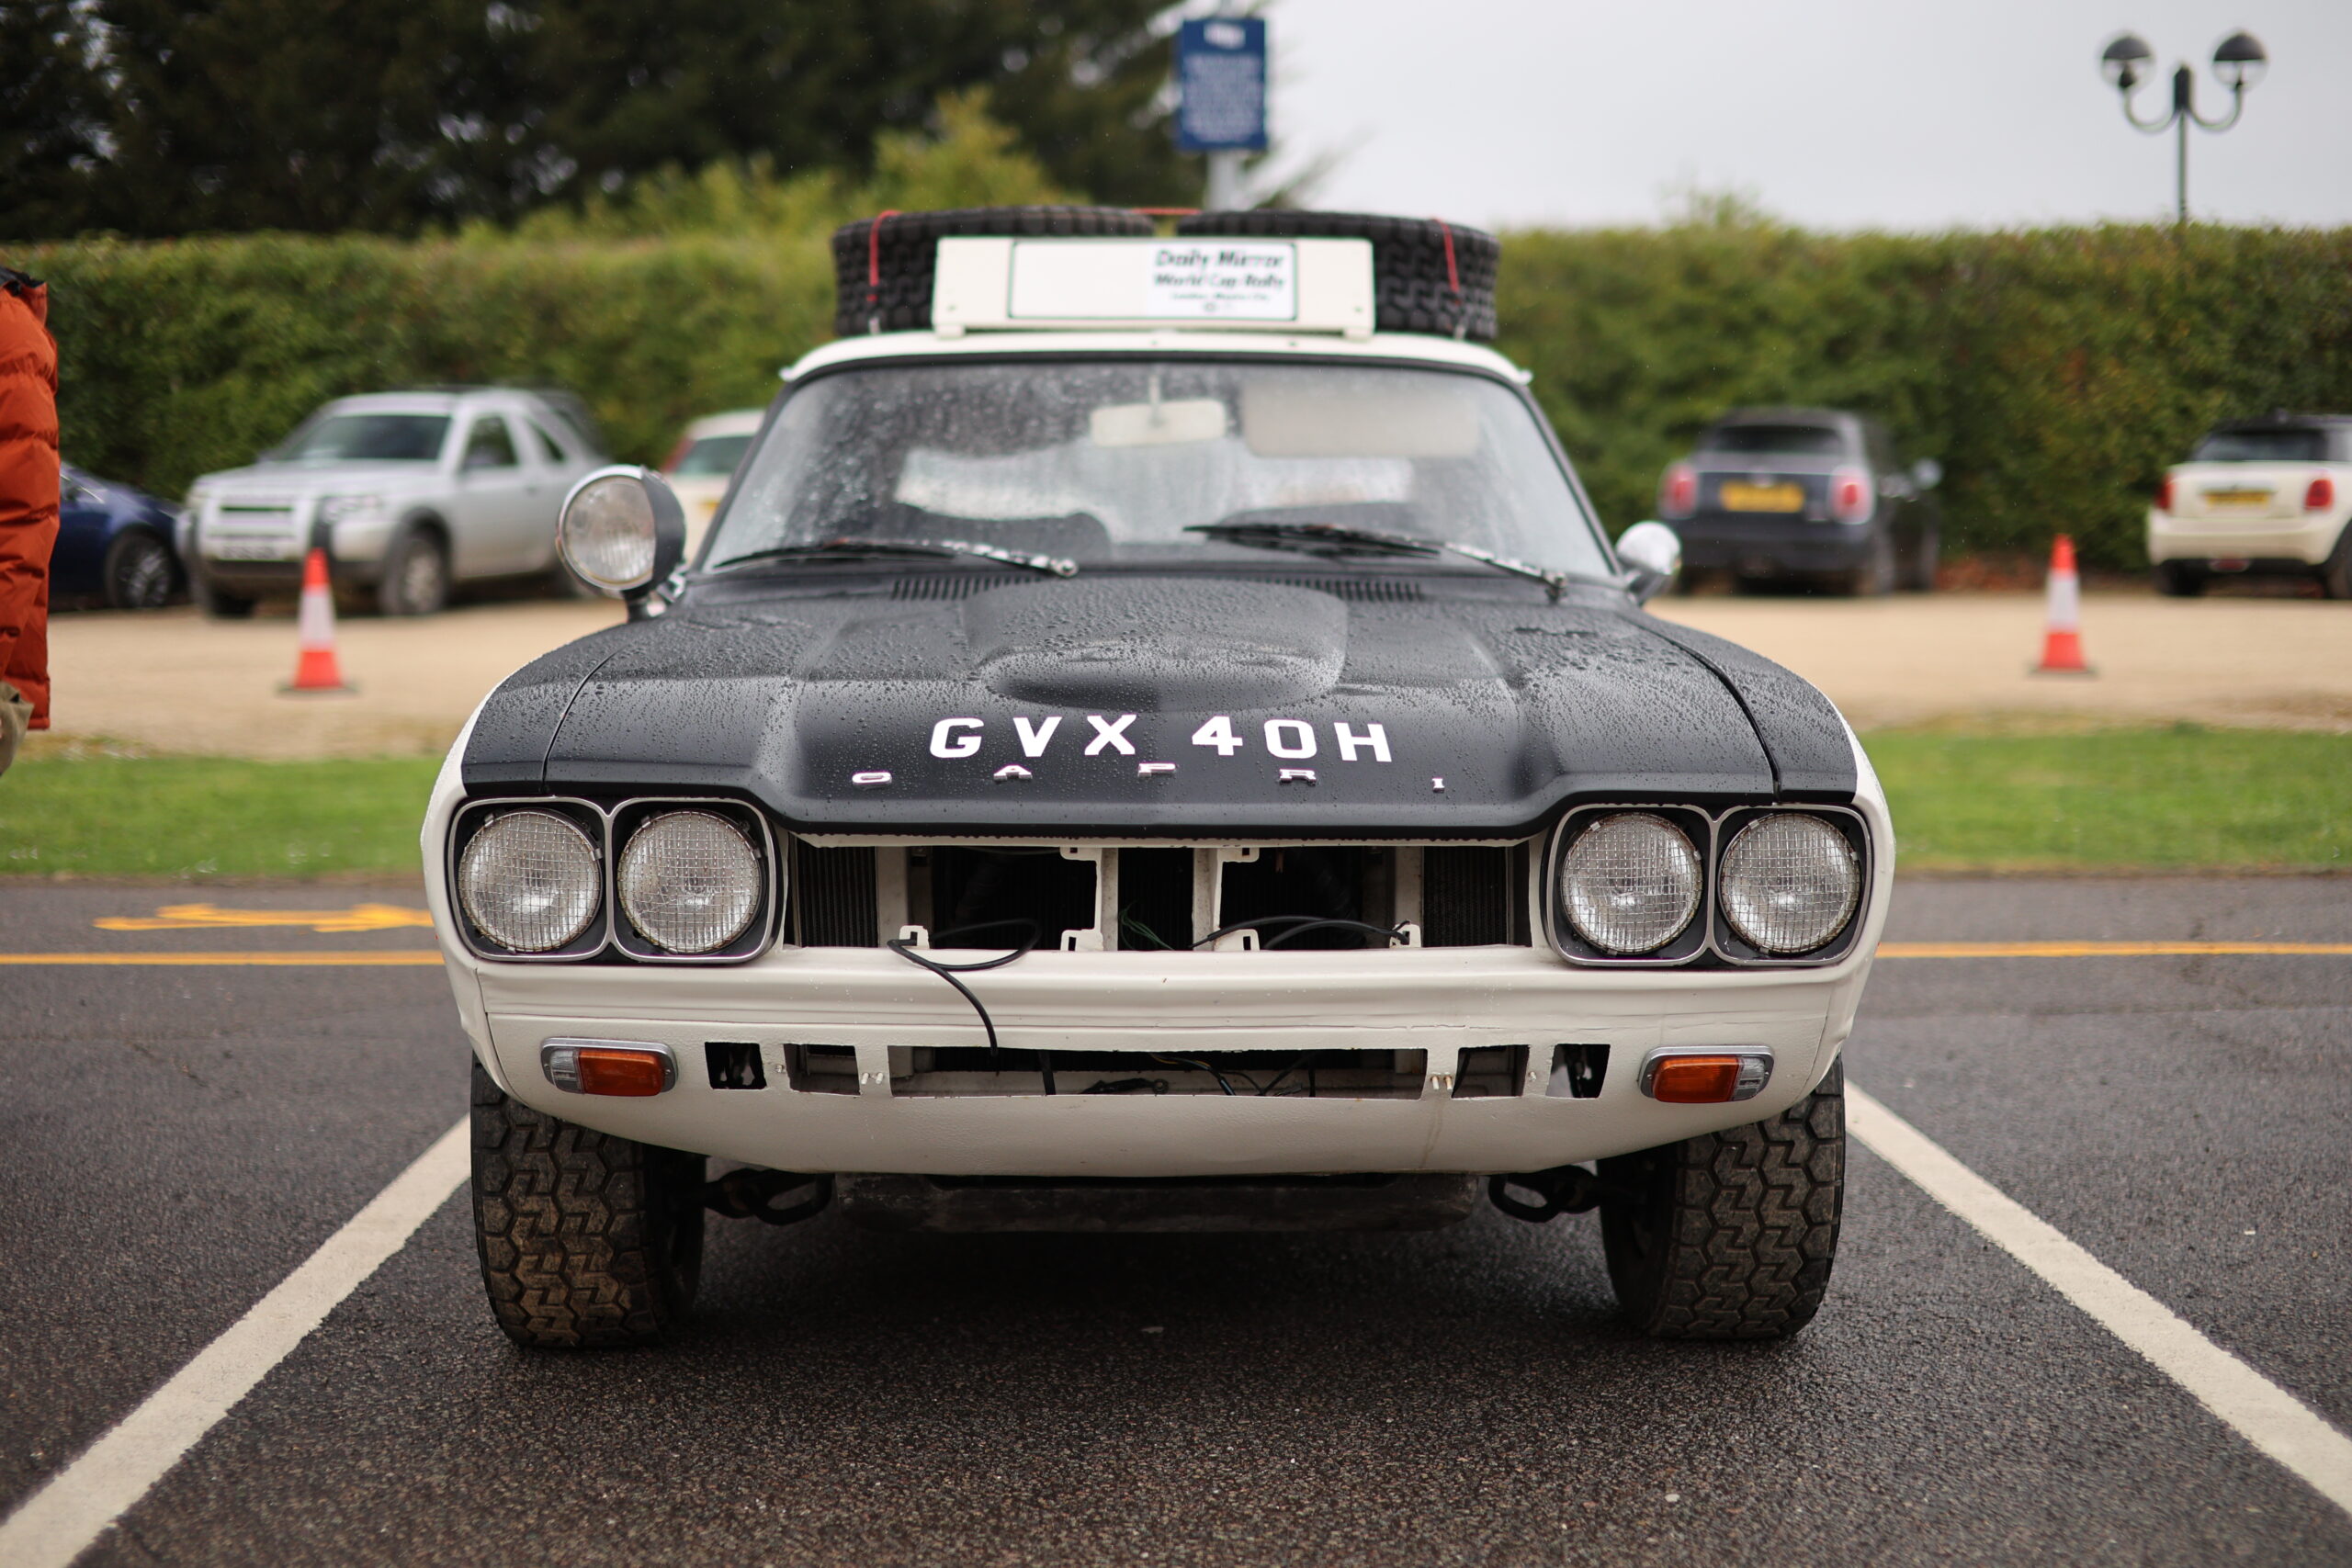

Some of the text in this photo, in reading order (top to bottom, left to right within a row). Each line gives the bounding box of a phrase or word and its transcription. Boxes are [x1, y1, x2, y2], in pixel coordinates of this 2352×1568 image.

[1155, 249, 1283, 270] Daily Mirror
[1155, 273, 1204, 288] World
[1245, 274, 1285, 290] Rally
[930, 714, 1392, 762] GVX 40H
